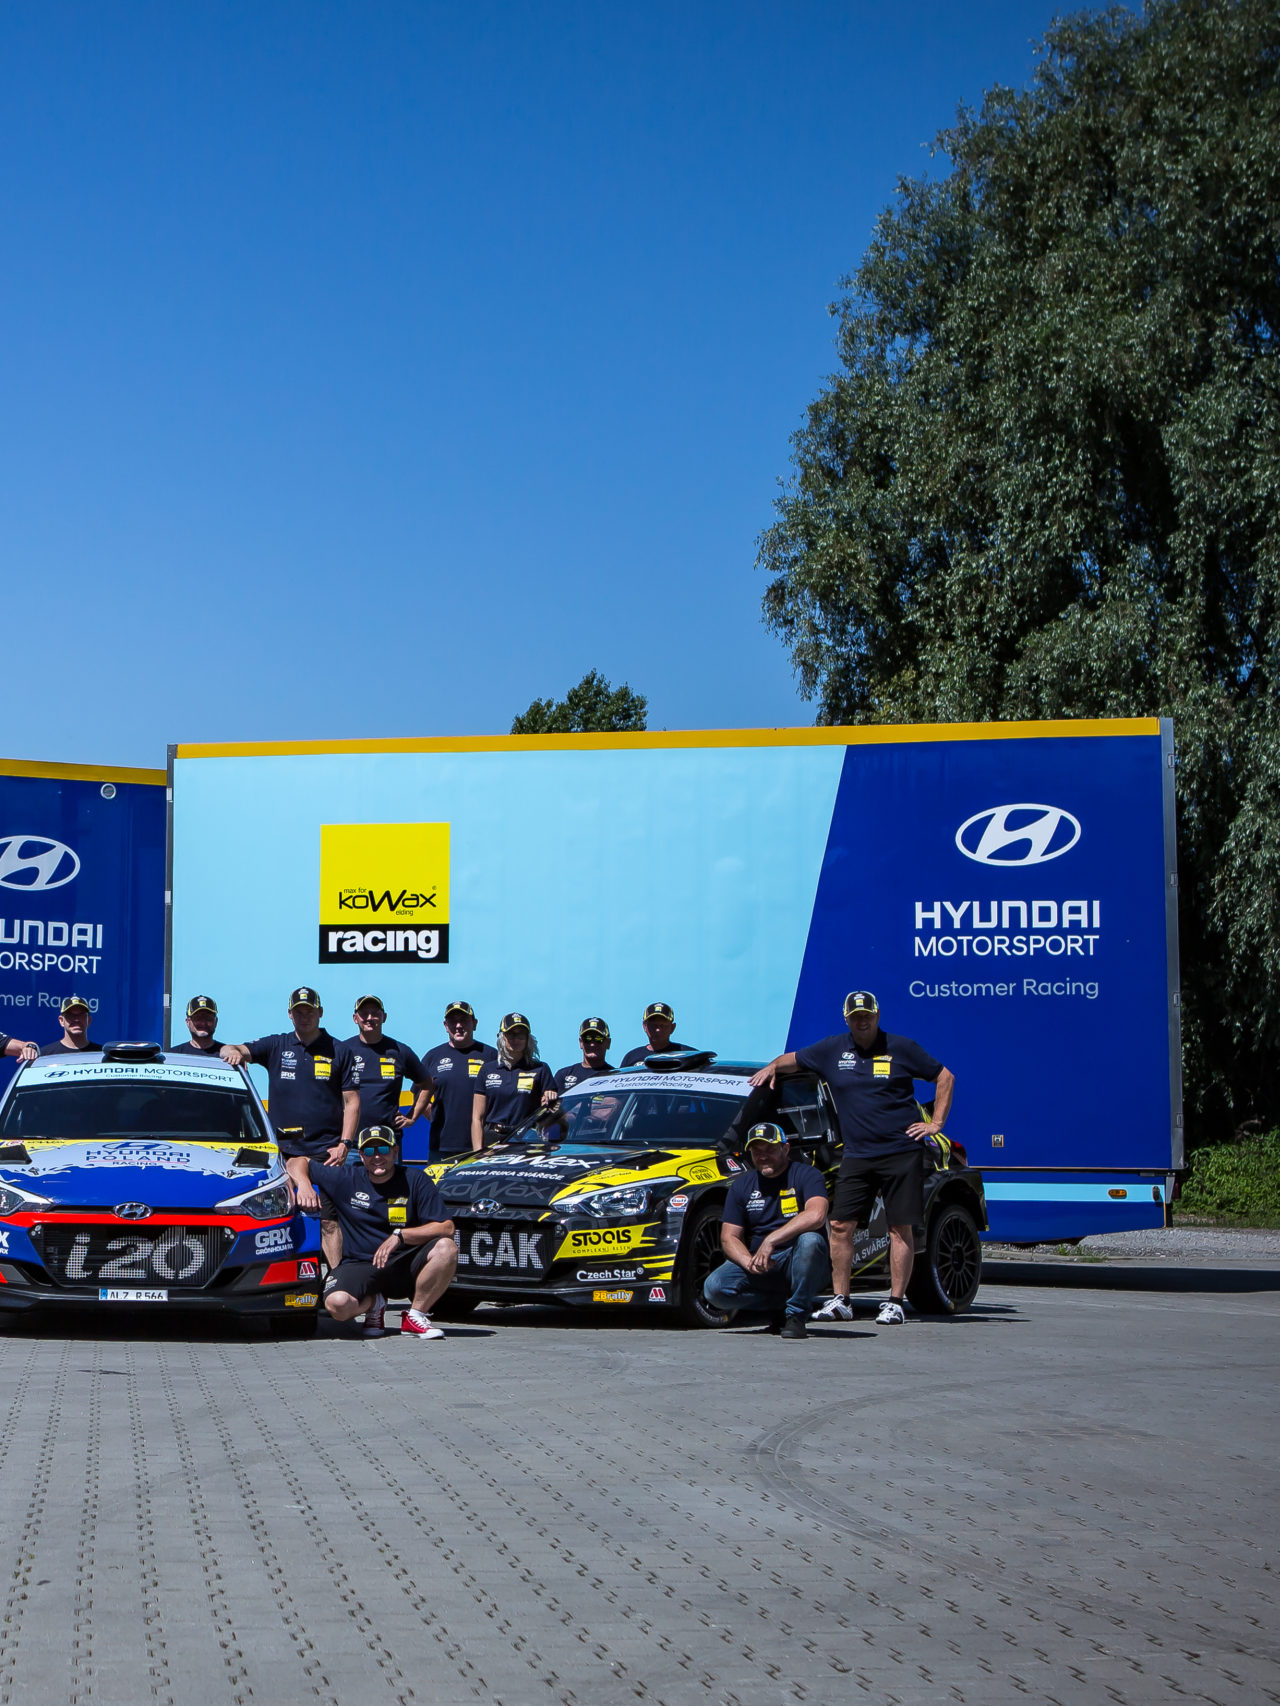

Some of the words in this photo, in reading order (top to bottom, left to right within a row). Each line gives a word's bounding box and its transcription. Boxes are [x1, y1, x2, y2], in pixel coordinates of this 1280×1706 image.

[339, 889, 437, 913] koWax
[914, 900, 1101, 929] HYUNDAI
[328, 929, 440, 959] racing
[914, 935, 1100, 957] MOTORSPORT
[909, 980, 1017, 998] Customer
[1023, 977, 1099, 999] Racing
[73, 1067, 139, 1076] HYUNDAI
[144, 1068, 235, 1083] MOTORSPORT
[609, 1074, 664, 1084] HYUNDAI
[664, 1075, 744, 1087] MOTORSPORT
[659, 1081, 693, 1089] Racing
[86, 1150, 191, 1158] HYUNDAI
[86, 1155, 191, 1163] POLAND
[254, 1226, 293, 1248] GRX
[64, 1231, 206, 1280] i20
[576, 1270, 612, 1281] Czech
[613, 1269, 636, 1279] Star
[286, 1294, 318, 1306] 2Brally
[593, 1290, 633, 1302] 2Brally
